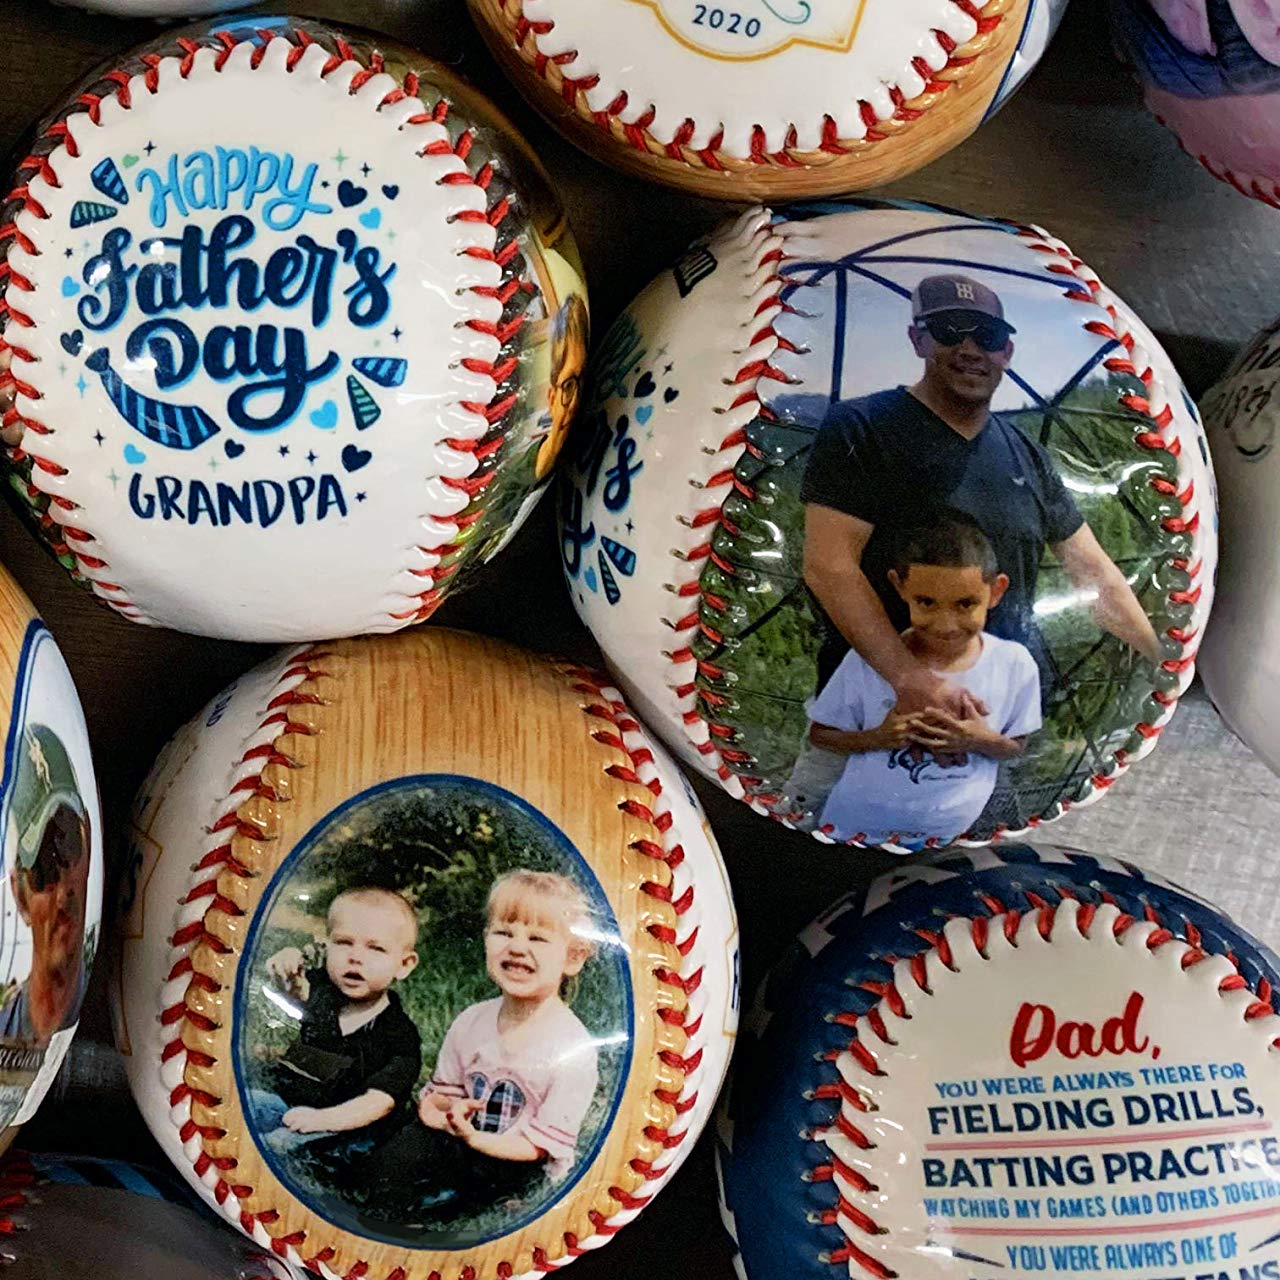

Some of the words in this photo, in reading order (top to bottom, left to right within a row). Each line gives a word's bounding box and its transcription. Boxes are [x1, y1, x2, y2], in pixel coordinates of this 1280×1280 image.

[692, 4, 762, 39] 2020
[136, 145, 333, 230] Happy
[77, 215, 398, 331] Father's
[125, 317, 341, 432] Day
[129, 471, 348, 529] GRANDPA
[1009, 991, 1161, 1067] Dad,
[936, 1082, 978, 1099] YOU
[982, 1076, 1046, 1096] WERE
[1052, 1071, 1135, 1092] ALWAYS
[1139, 1064, 1205, 1086] THERE
[1209, 1062, 1247, 1080] FOR
[927, 1098, 1114, 1135] FIELDING
[1122, 1087, 1265, 1126] DRILLS,
[922, 1155, 1096, 1188] BATTING
[923, 1197, 1010, 1220] WATCHING
[1015, 1198, 1040, 1219] MY
[1047, 1197, 1107, 1219] GAMES
[1111, 1194, 1154, 1217] (AND
[1156, 1188, 1218, 1213] OTHERS
[1006, 1245, 1046, 1272] YOU
[1050, 1244, 1099, 1271] WERE
[1104, 1239, 1176, 1270] ALWAYS
[1181, 1235, 1216, 1265] ONE
[1218, 1232, 1238, 1259] OF
